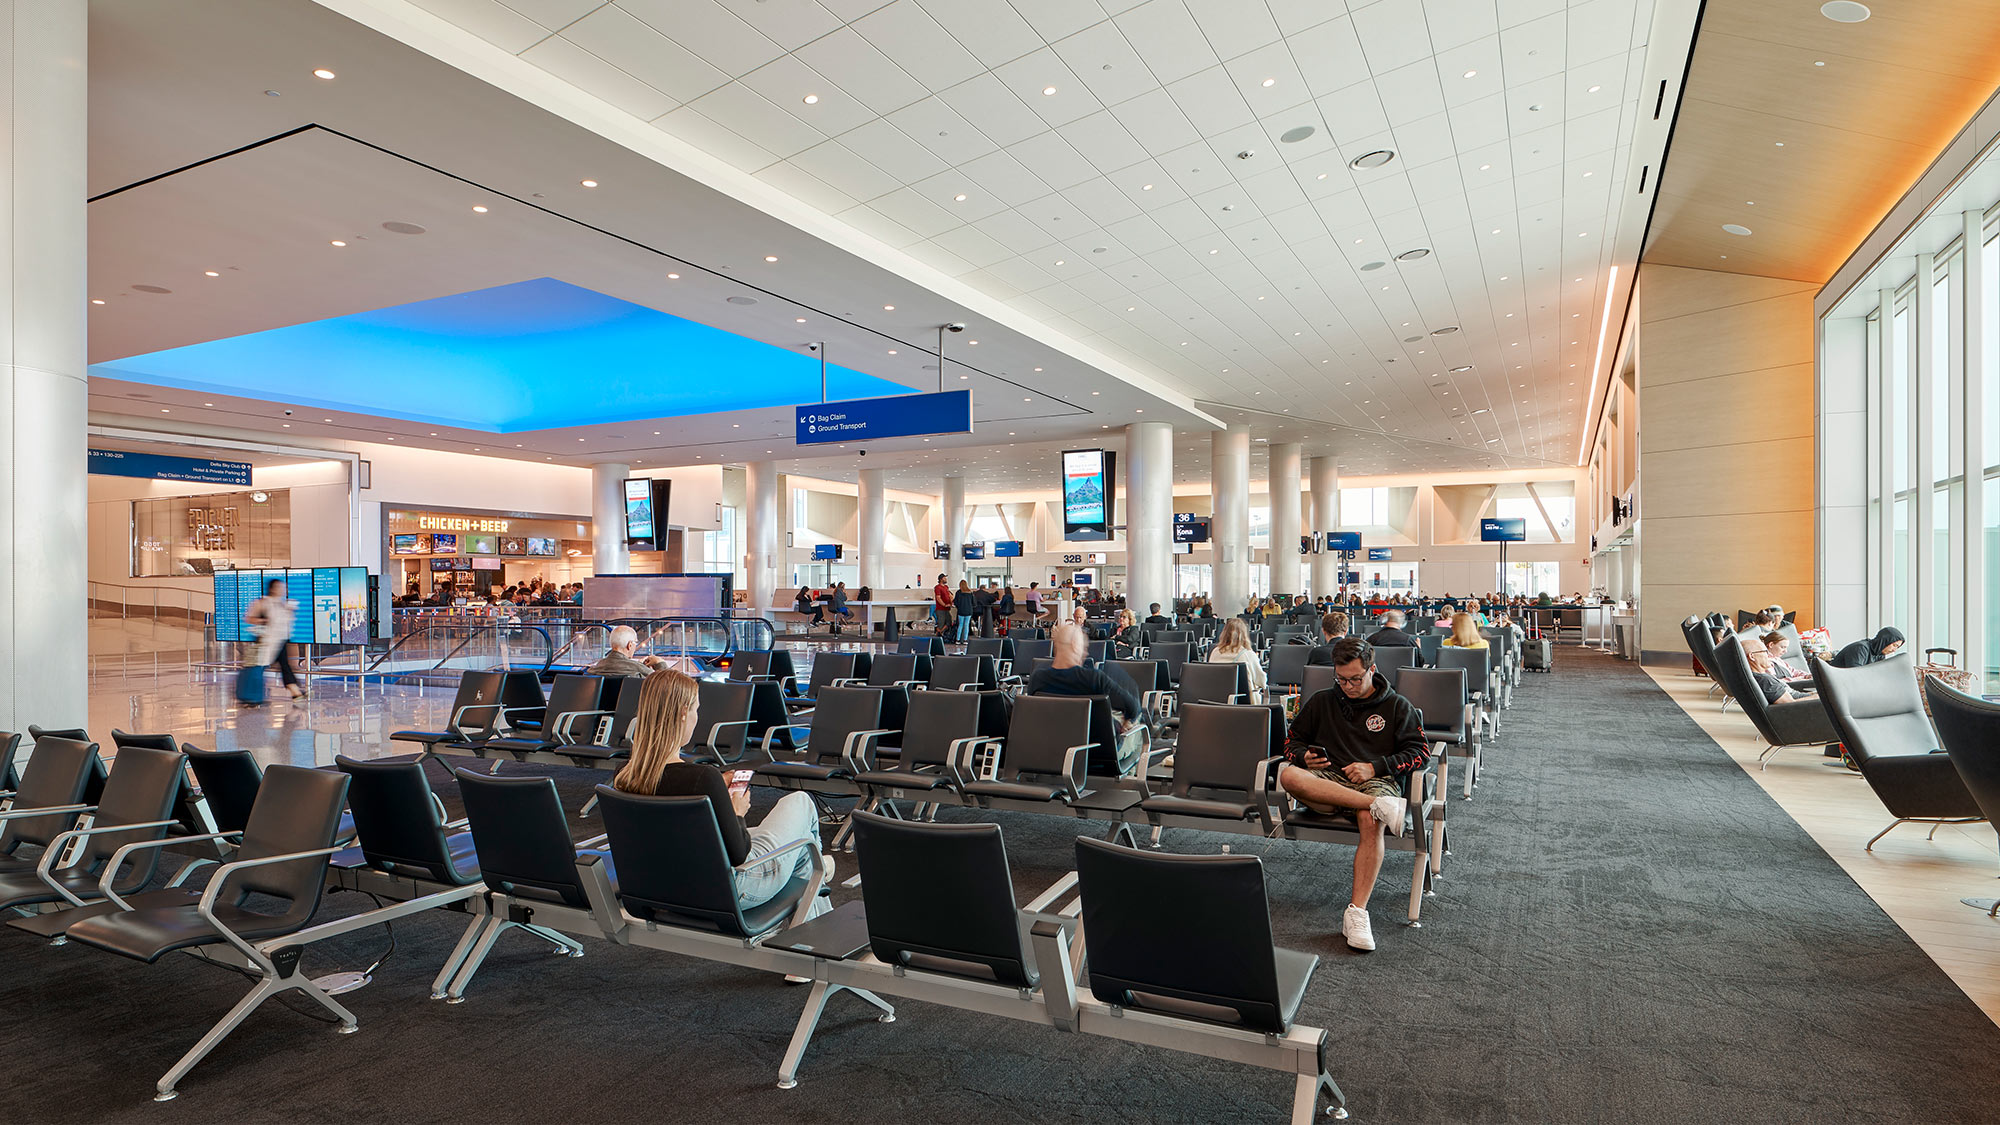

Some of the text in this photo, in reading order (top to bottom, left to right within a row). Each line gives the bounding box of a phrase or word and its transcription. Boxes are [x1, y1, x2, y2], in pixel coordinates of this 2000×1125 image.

[817, 413, 847, 423] Bag Claim
[817, 421, 867, 432] Ground Transport
[201, 475, 222, 483] Transport
[1178, 513, 1190, 522] 36
[419, 516, 509, 533] CHICKEN+BEER
[1176, 528, 1193, 536] Kona
[1063, 554, 1082, 564] 32B
